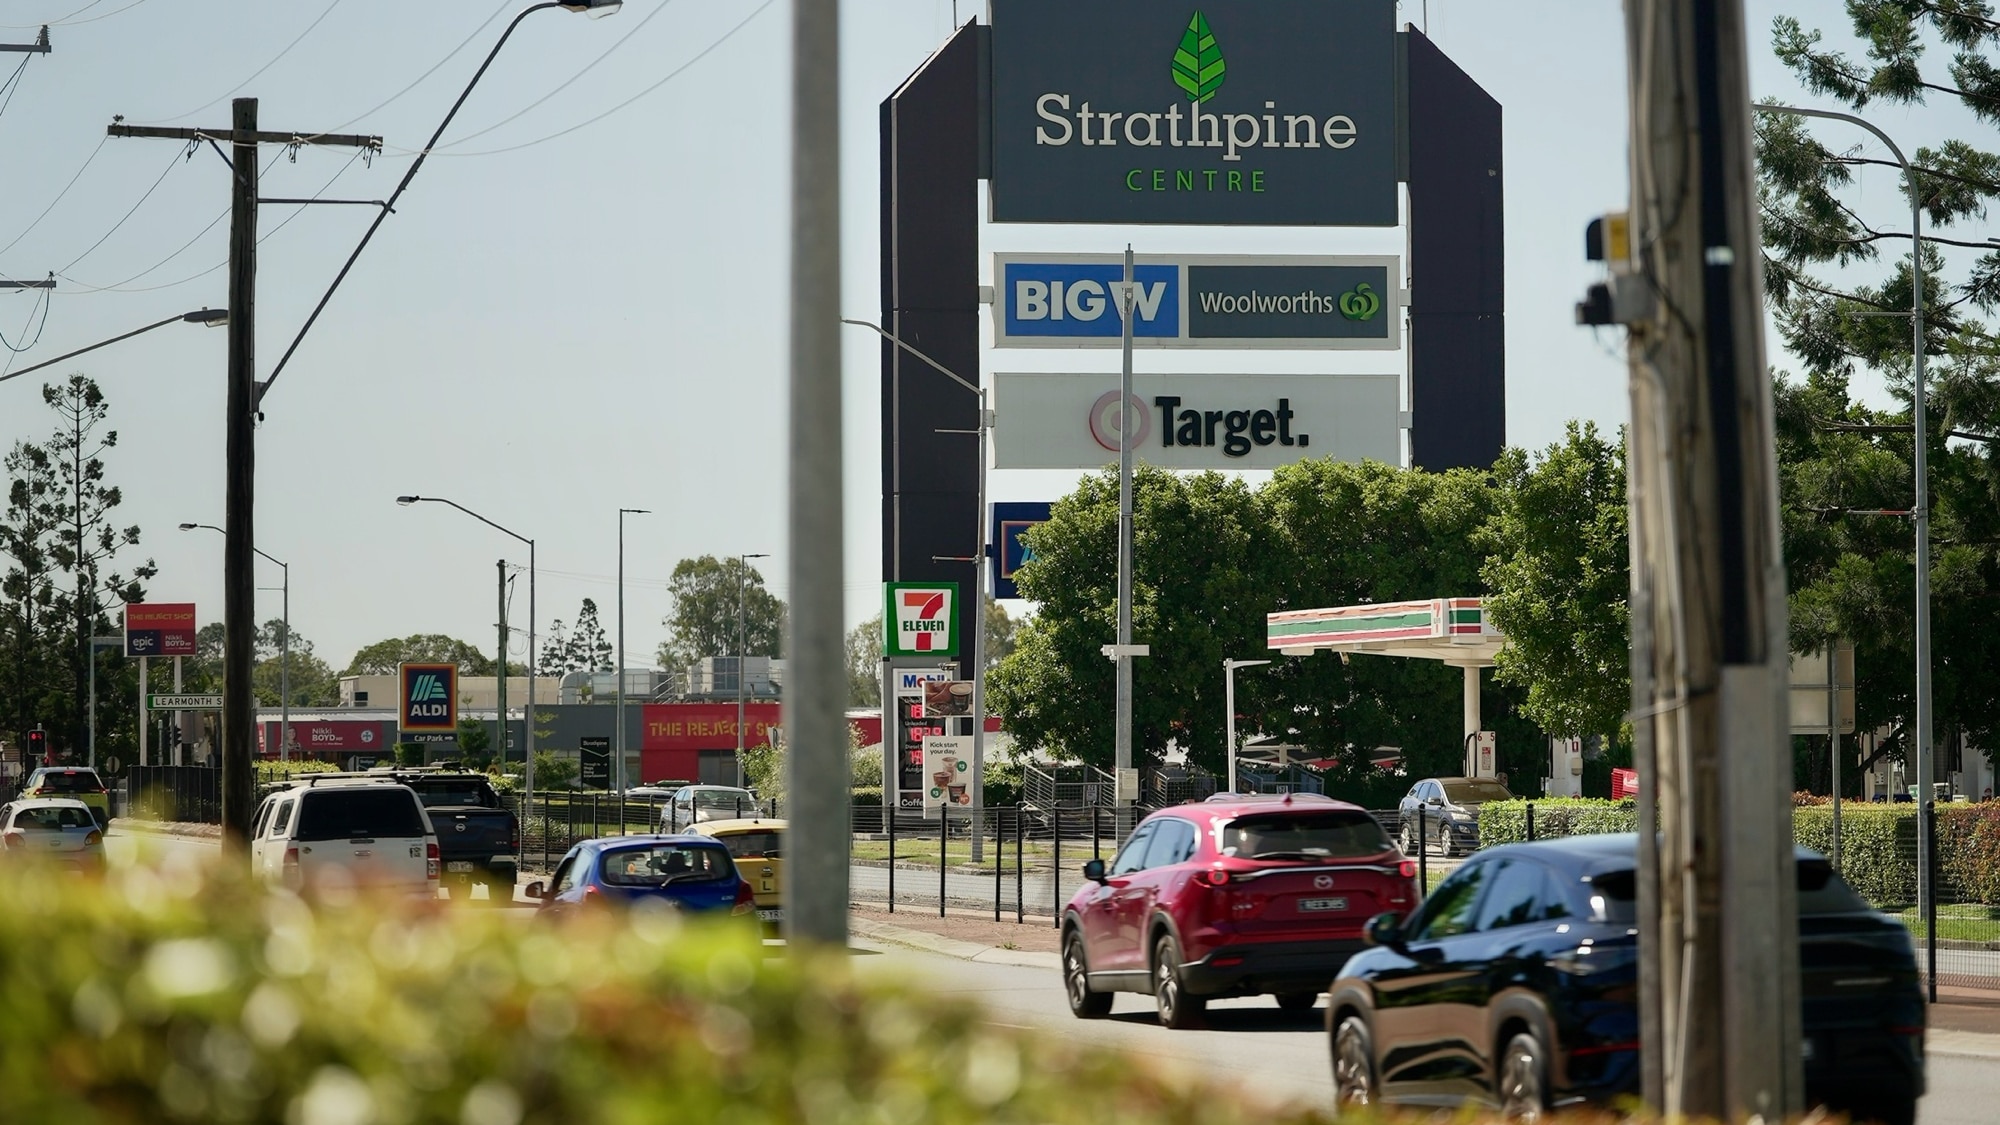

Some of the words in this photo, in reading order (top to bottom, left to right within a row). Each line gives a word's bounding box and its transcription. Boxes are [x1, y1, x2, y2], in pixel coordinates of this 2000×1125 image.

[1036, 93, 1357, 161] Strathpine
[1126, 170, 1266, 192] CENTRE
[1199, 290, 1333, 315] Woolworths
[1155, 396, 1310, 457] Target.
[132, 636, 154, 648] epic
[410, 704, 447, 716] ALDI
[649, 722, 682, 736] THE
[687, 720, 751, 737] REJECT
[1478, 732, 1482, 742] 6
[1490, 732, 1495, 742] 5
